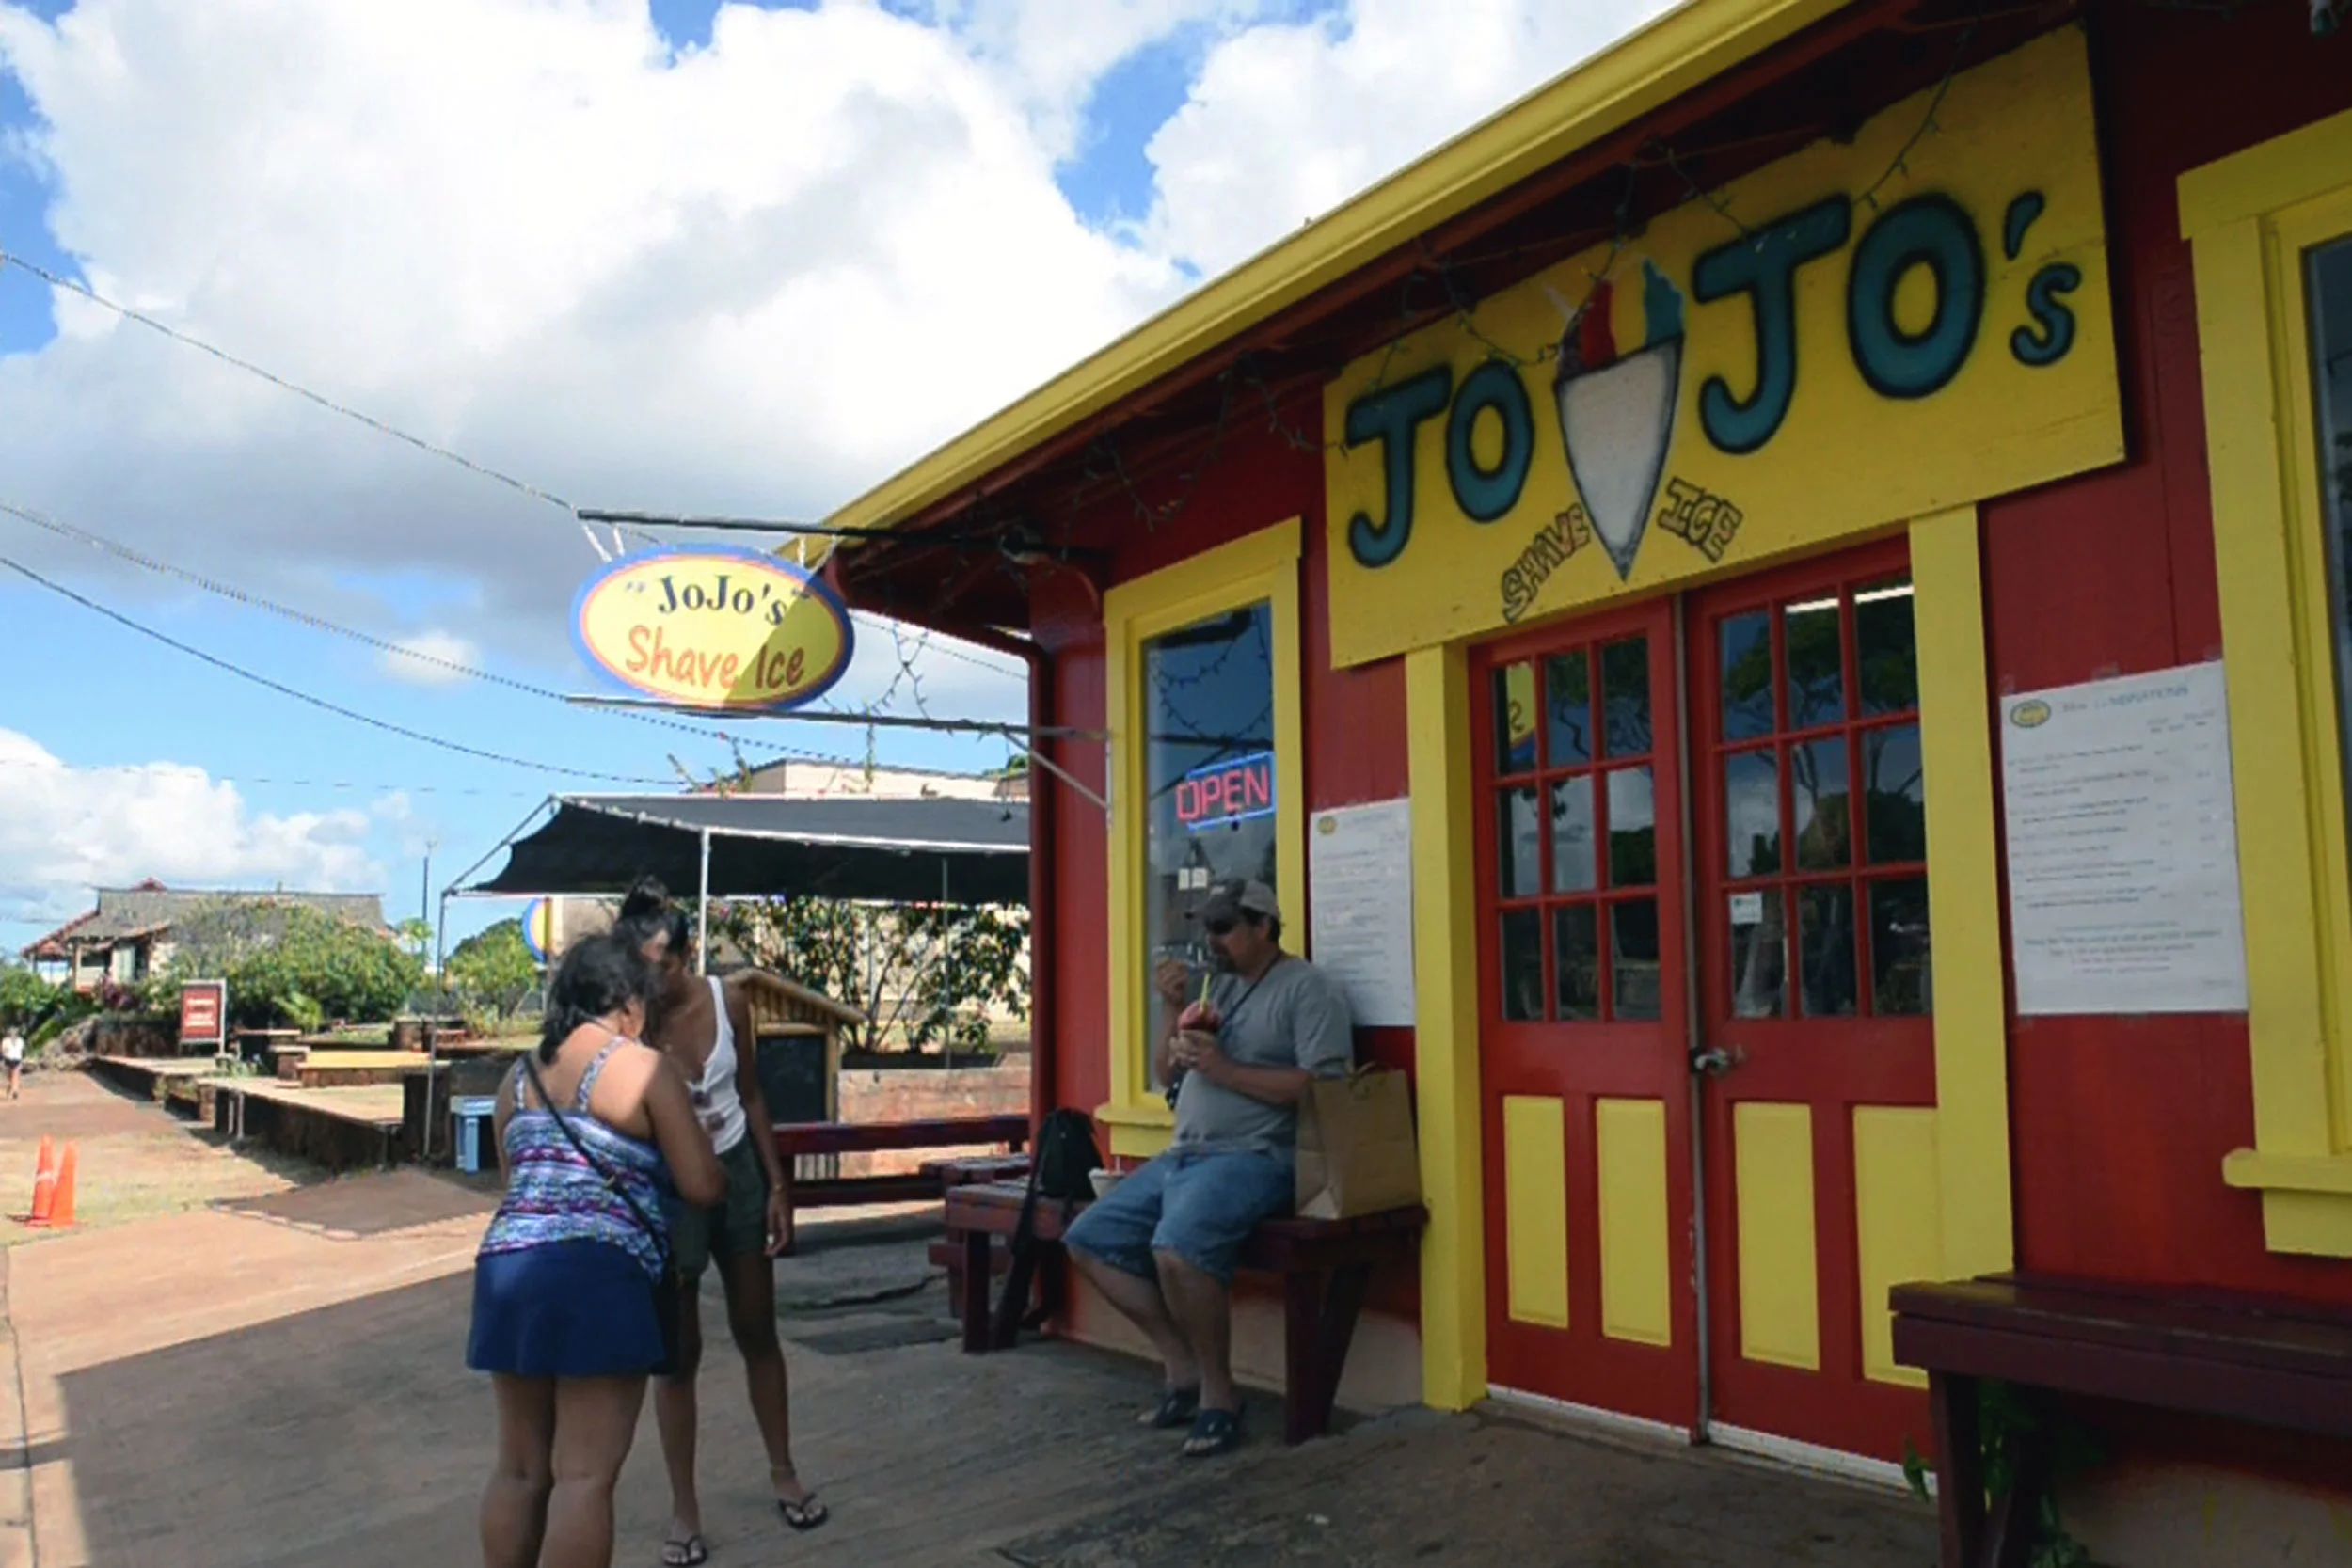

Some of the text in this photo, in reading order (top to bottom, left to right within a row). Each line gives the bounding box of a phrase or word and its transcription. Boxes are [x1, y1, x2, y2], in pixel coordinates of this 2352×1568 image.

[1345, 191, 2083, 569] JO JO's
[1501, 476, 1744, 625] SHAVE ICE
[625, 624, 805, 690] Shave Ice
[1176, 764, 1268, 820] OPEN
